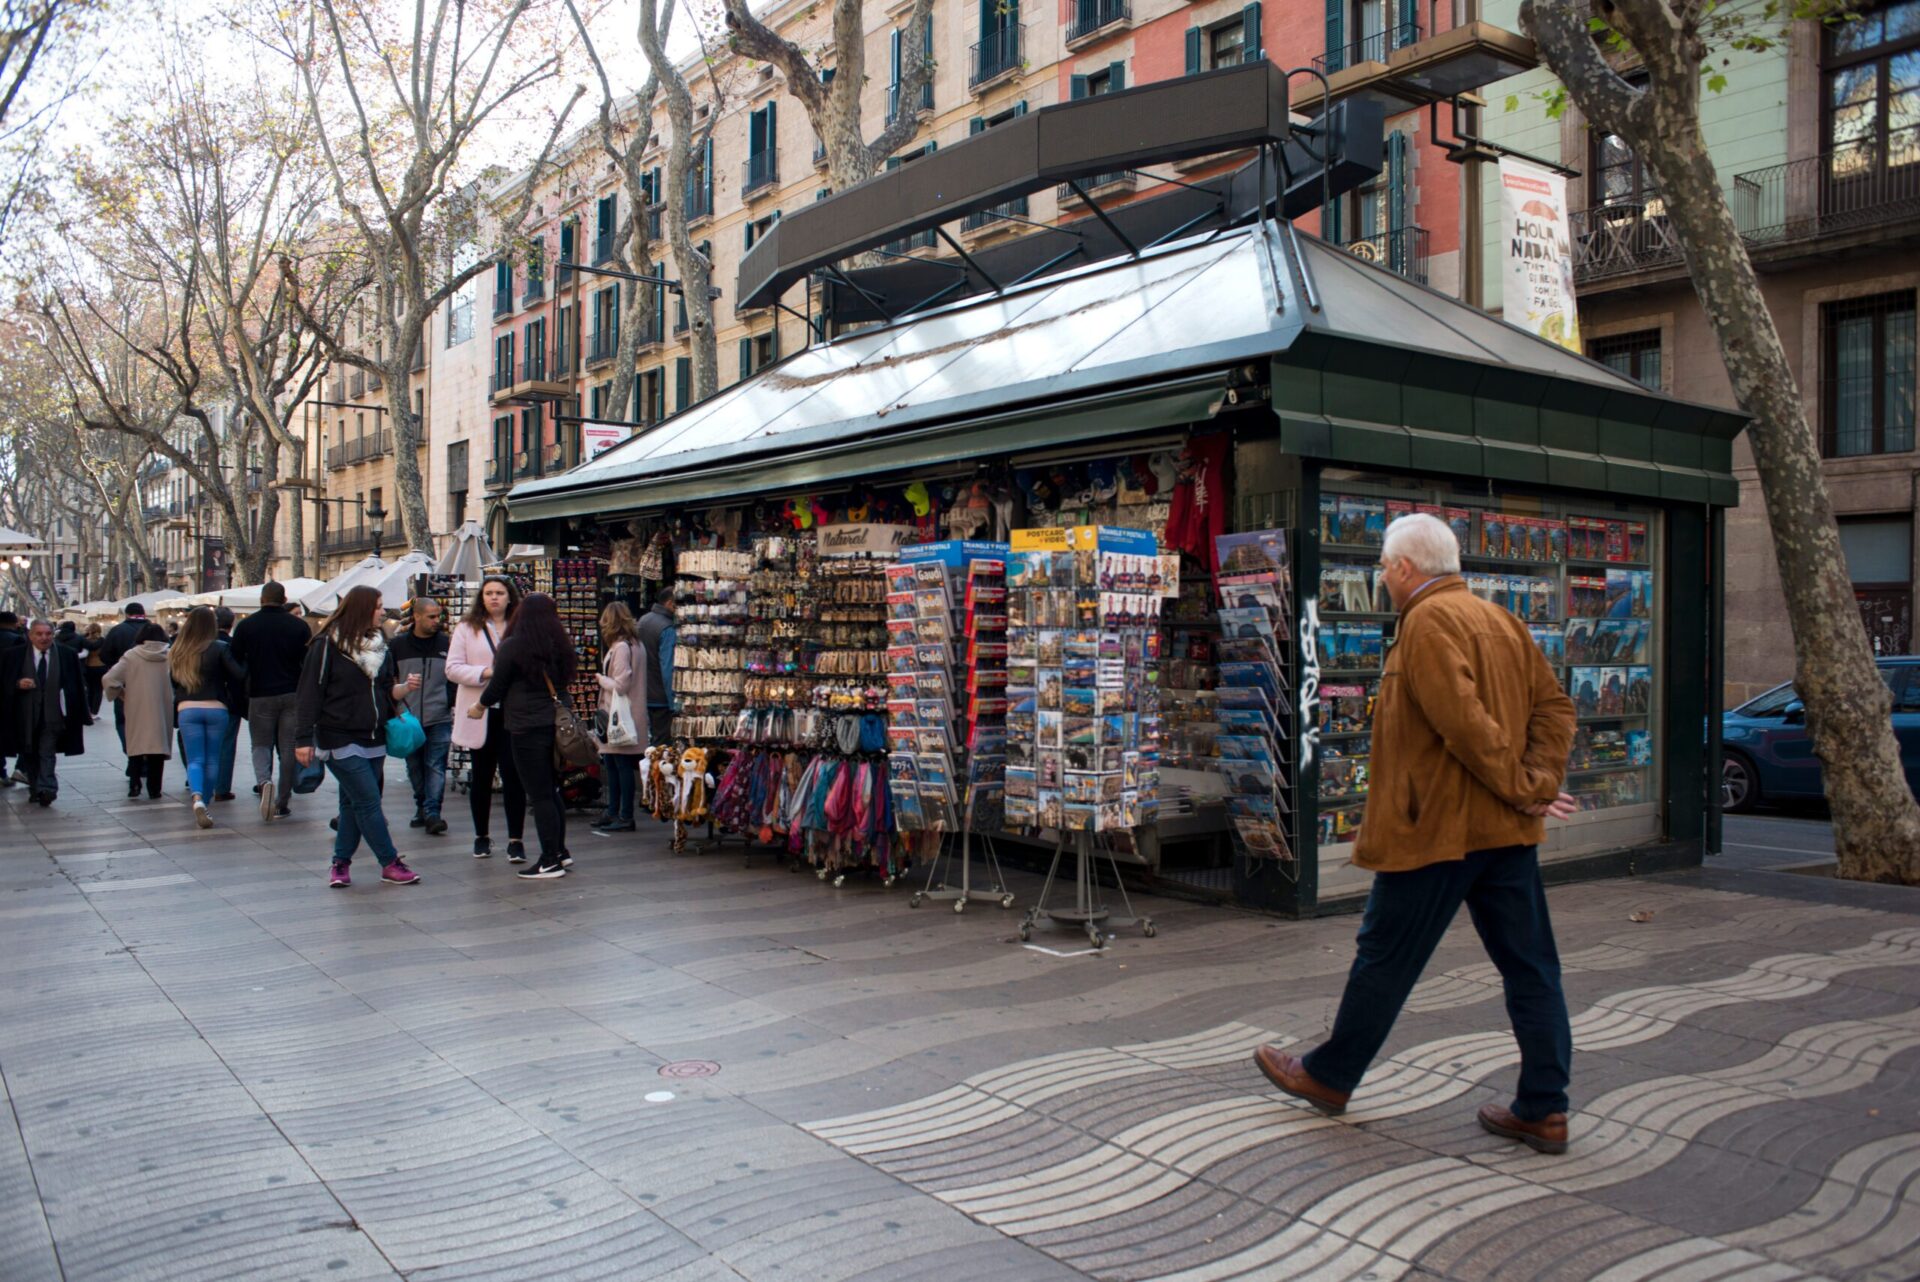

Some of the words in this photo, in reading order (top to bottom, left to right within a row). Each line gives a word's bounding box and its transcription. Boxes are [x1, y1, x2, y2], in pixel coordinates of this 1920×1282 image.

[1516, 218, 1554, 240] HOLA
[1511, 238, 1559, 264] NADAL
[824, 527, 869, 547] Natural
[1026, 529, 1065, 539] POSTCARD
